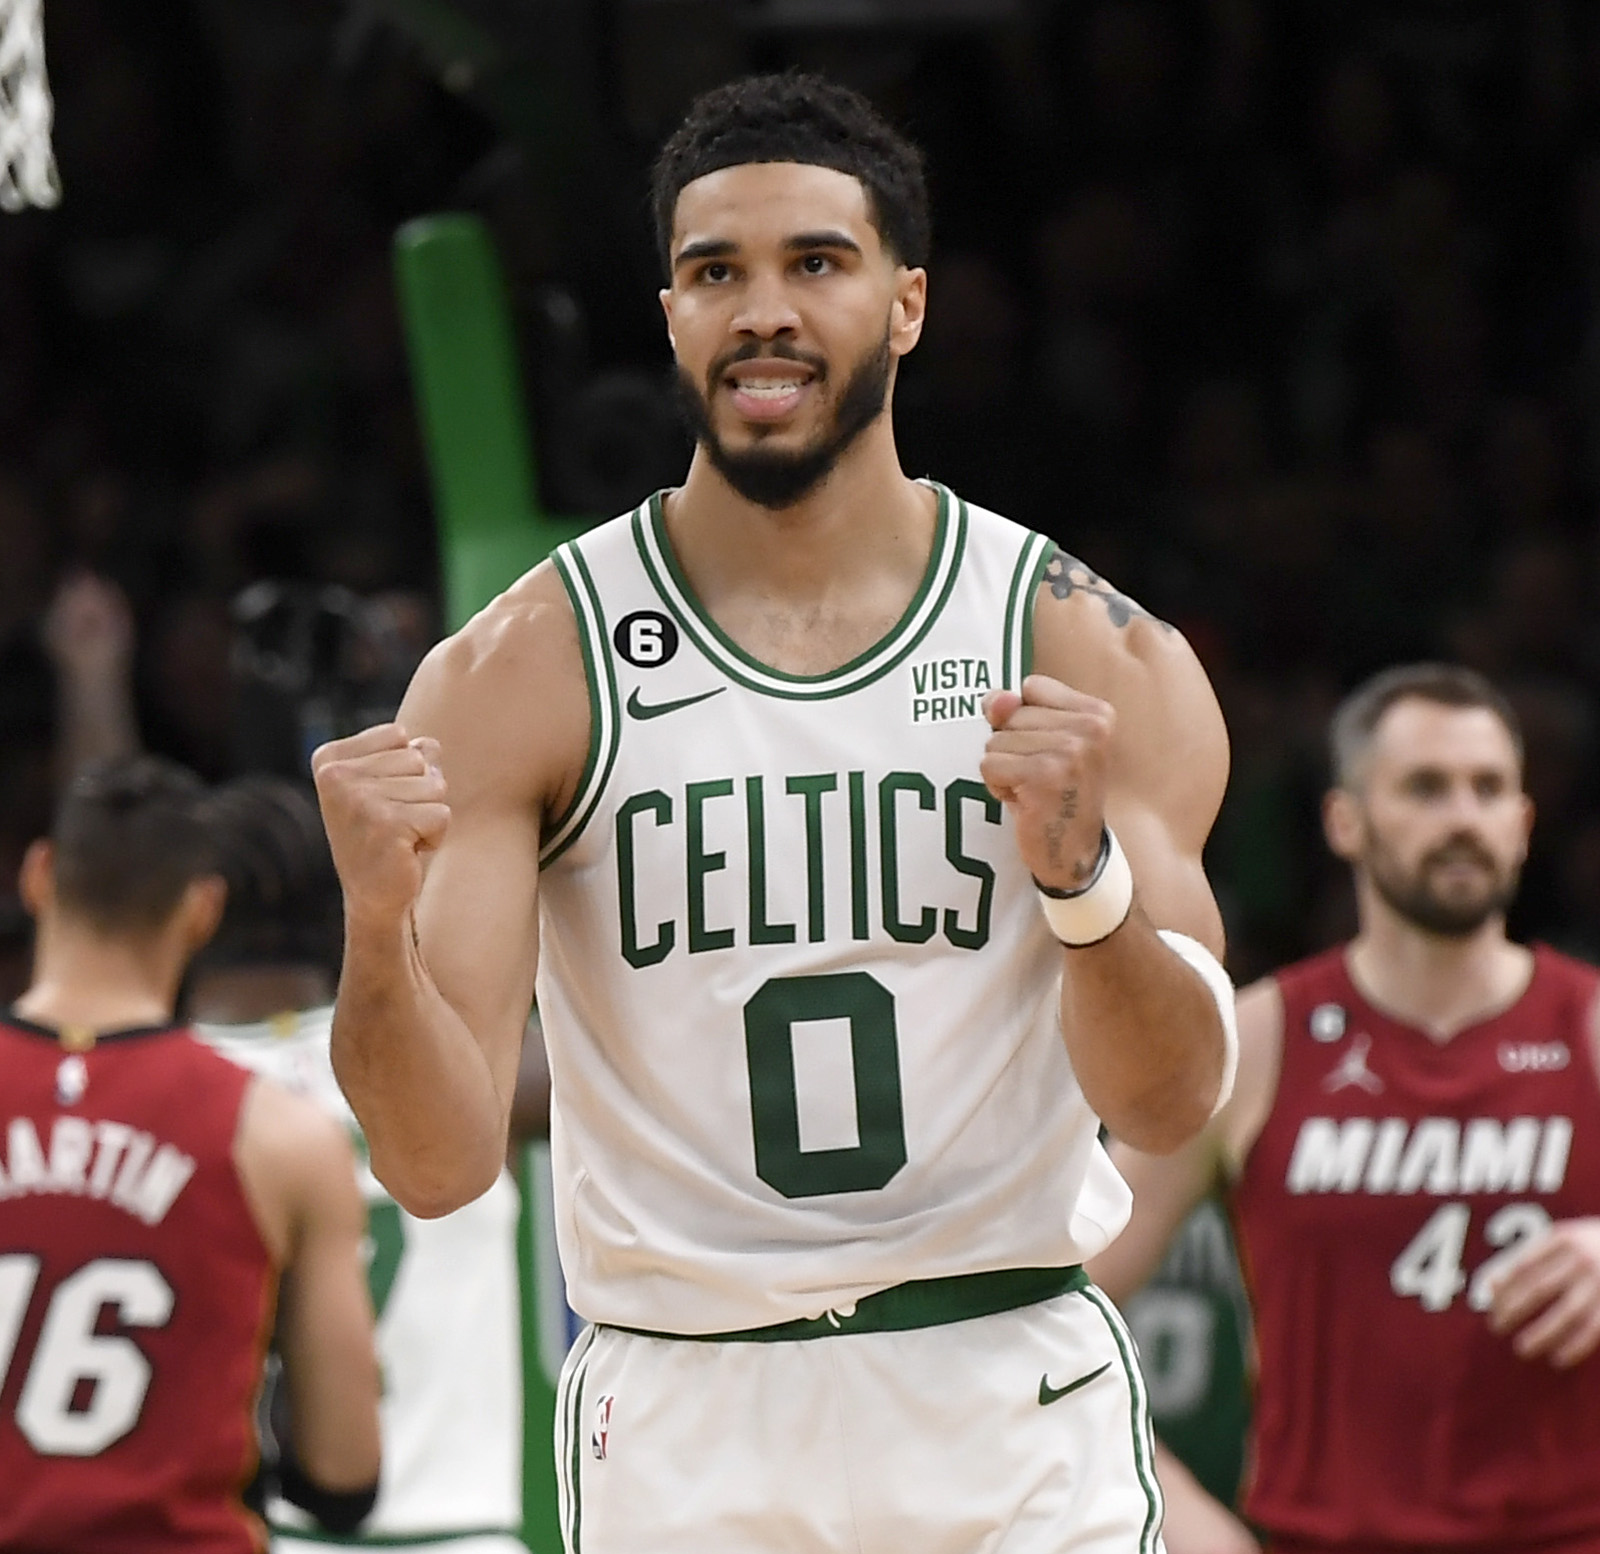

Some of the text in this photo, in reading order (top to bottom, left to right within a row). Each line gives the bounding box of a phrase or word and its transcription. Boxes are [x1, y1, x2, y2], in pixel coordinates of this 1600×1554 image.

[630, 620, 664, 662] 6
[911, 659, 991, 695] VISTA
[913, 693, 986, 722] PRIN
[616, 771, 1002, 969] CELTICS
[743, 970, 908, 1199] 0
[1285, 1115, 1574, 1196] MIAMI
